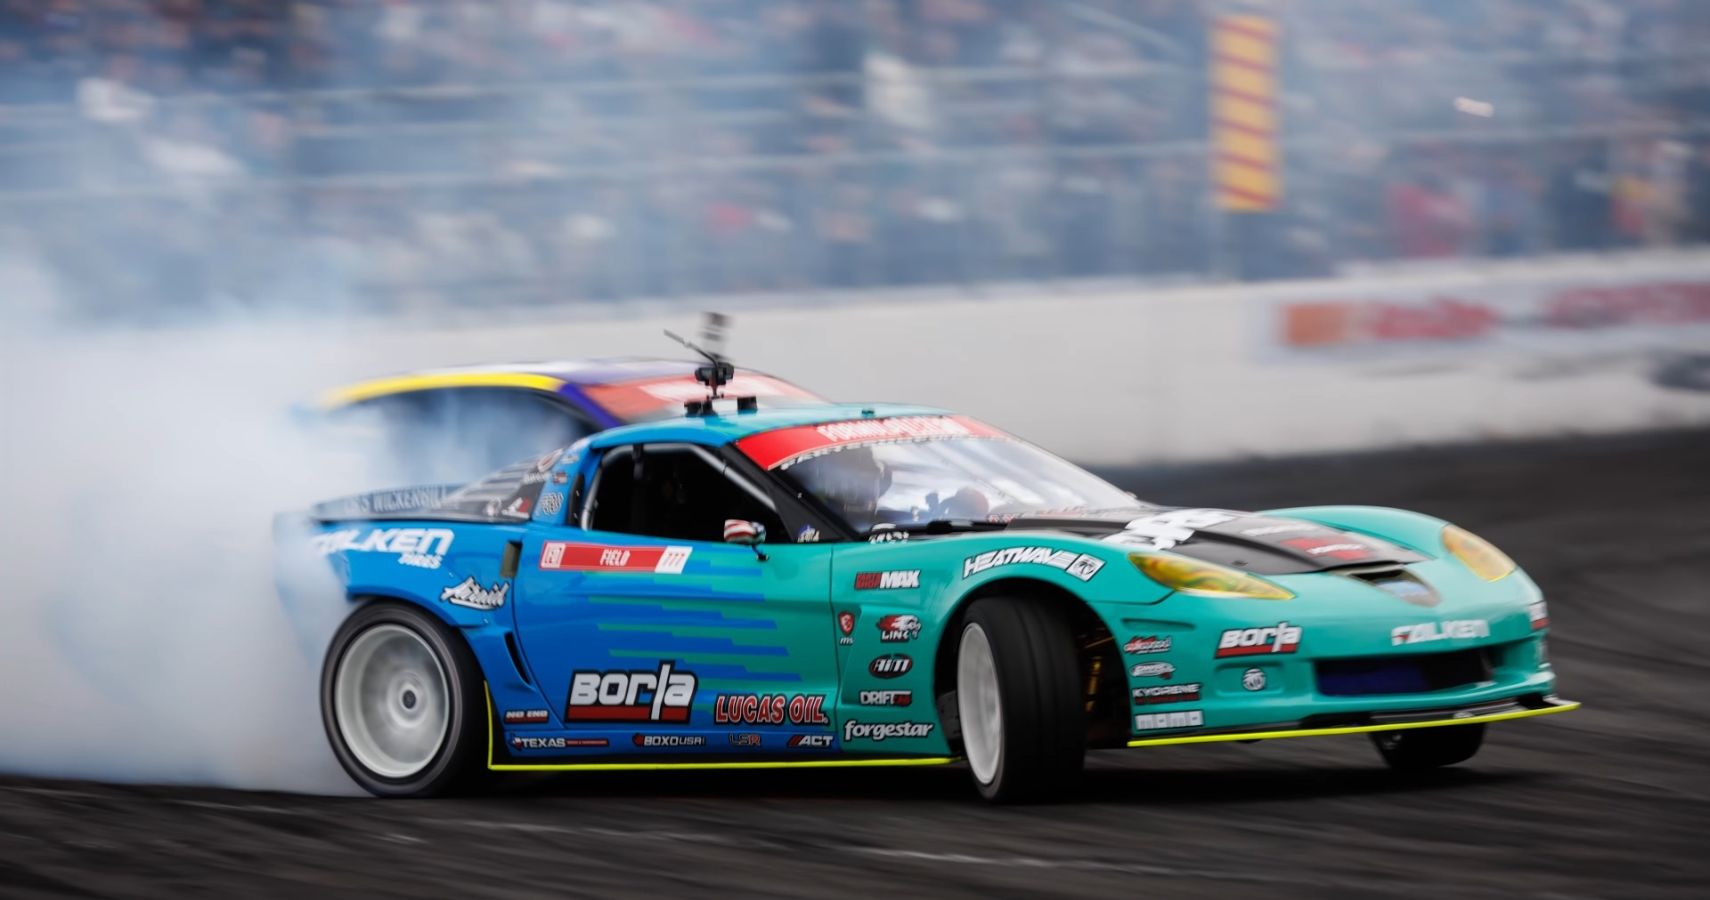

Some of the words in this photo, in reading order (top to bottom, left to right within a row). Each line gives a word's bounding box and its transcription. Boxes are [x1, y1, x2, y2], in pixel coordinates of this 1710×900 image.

[600, 549, 631, 567] FIELD
[963, 547, 1078, 578] HEATWAVE
[880, 570, 920, 588] MAX
[1391, 619, 1490, 646] FALKEN
[860, 690, 911, 706] DRIFT
[716, 695, 785, 723] LUCAS
[788, 697, 825, 723] OIL
[844, 720, 933, 741] forgestar
[521, 738, 566, 748] TEXAS
[799, 735, 834, 746] ACT
